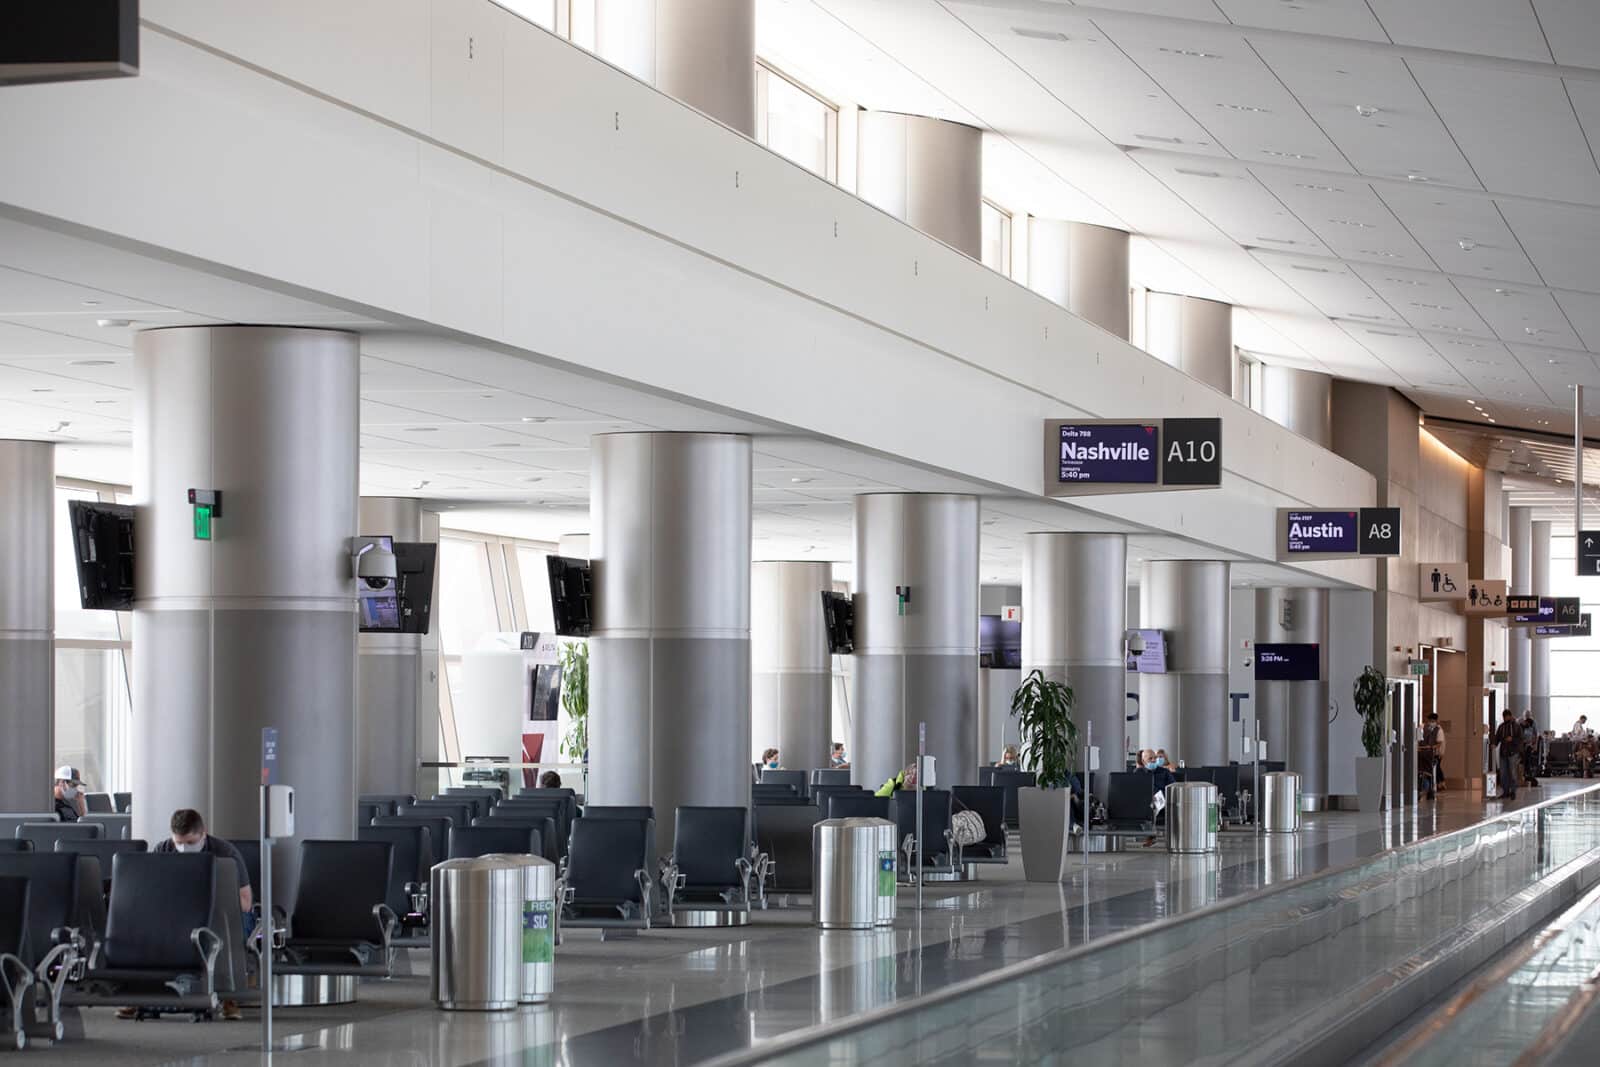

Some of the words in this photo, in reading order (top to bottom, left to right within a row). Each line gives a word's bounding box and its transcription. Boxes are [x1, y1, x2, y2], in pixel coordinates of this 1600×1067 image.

[1061, 441, 1150, 461] Nashville
[1167, 440, 1216, 462] A10
[1061, 471, 1078, 479] 5:40
[1078, 472, 1090, 480] pm
[1289, 522, 1344, 538] Austin
[1368, 523, 1392, 539] A8
[1561, 605, 1576, 615] A6
[533, 914, 548, 929] SLC
